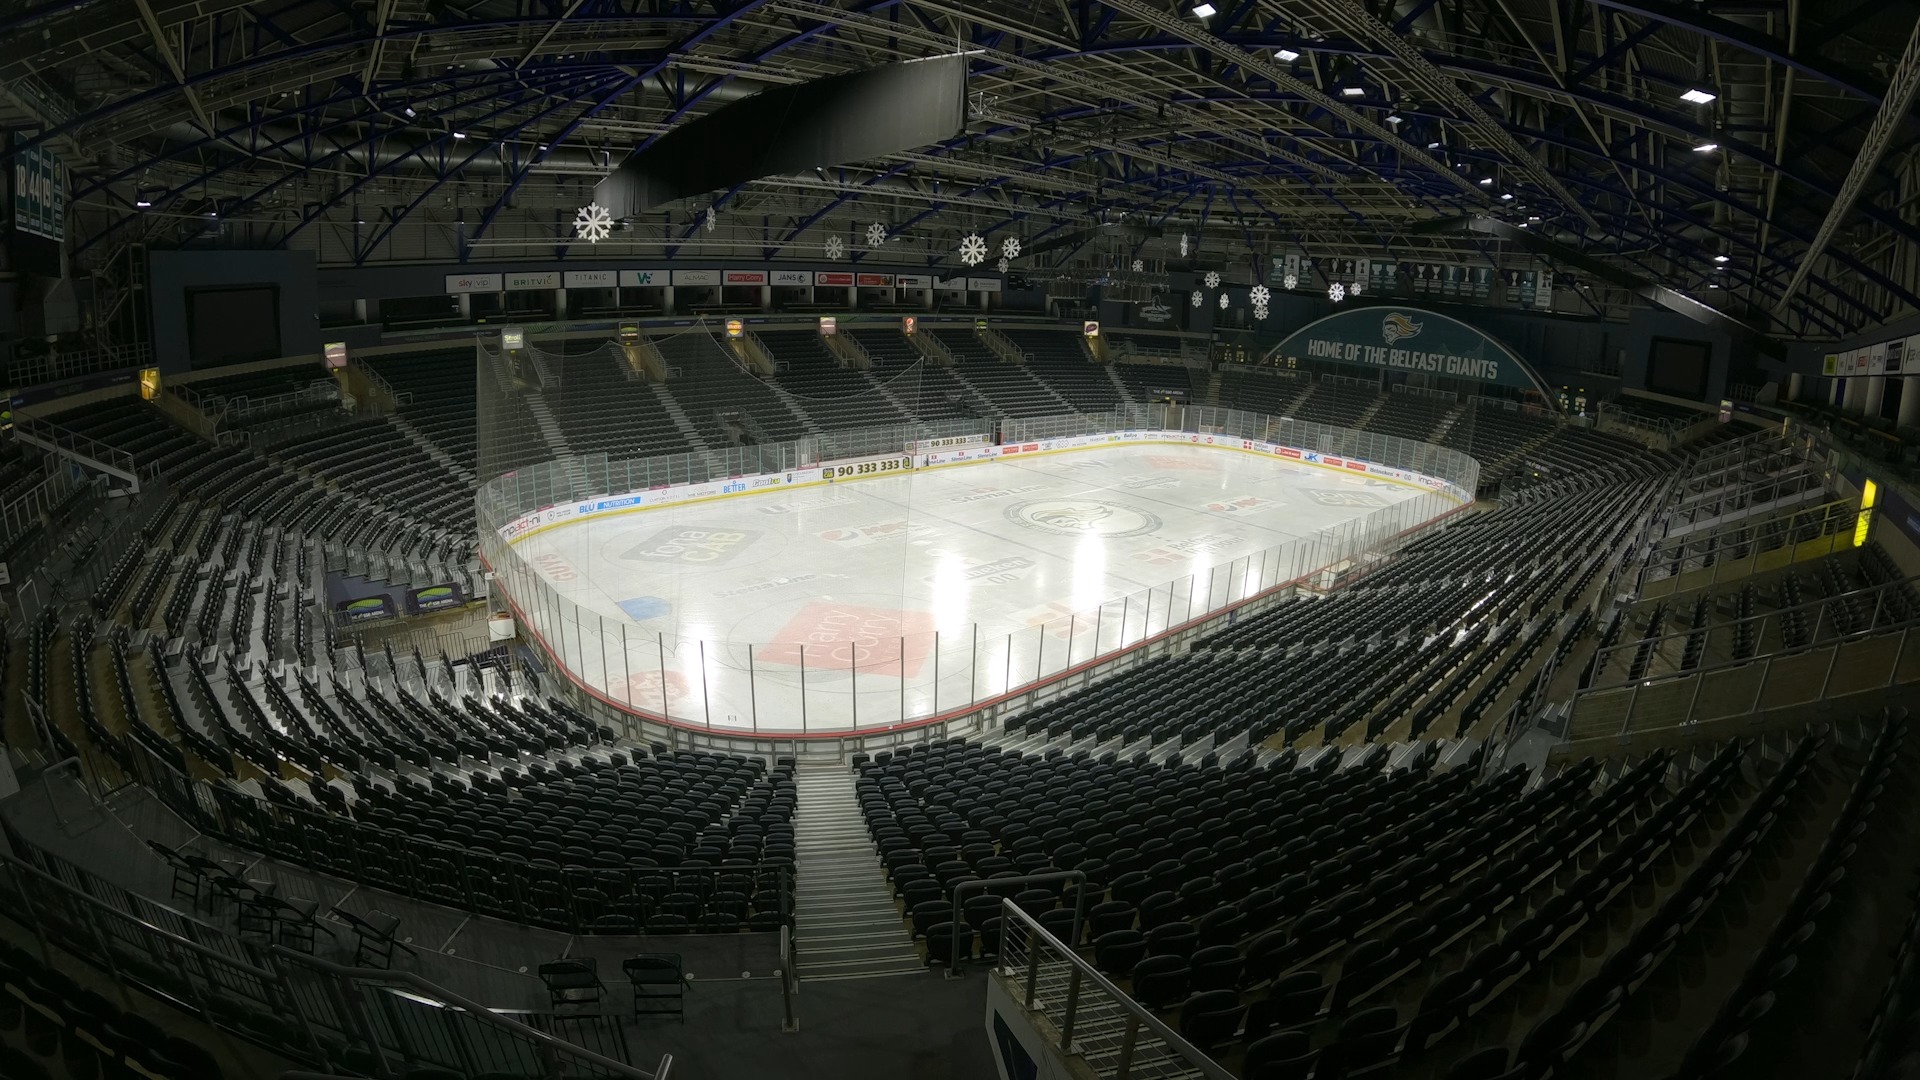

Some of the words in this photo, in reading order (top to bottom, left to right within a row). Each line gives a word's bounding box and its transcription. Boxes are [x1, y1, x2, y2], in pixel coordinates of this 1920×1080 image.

[16, 163, 26, 198] 18
[30, 170, 40, 204] 44
[42, 176, 51, 209] 19
[459, 279, 473, 289] sky
[513, 277, 553, 286] BRITVIC
[575, 273, 607, 281] TITANIC
[1308, 339, 1343, 360] HOME
[1344, 343, 1362, 362] OF
[1364, 345, 1387, 365] THE
[1389, 349, 1445, 373] BELFAST
[1446, 356, 1499, 380] GIANTS
[837, 466, 854, 477] 90
[857, 464, 877, 474] 333
[880, 460, 900, 471] 333
[723, 483, 746, 493] BETTER
[604, 498, 635, 508] NUTRITION
[784, 609, 860, 657] Harry
[830, 613, 901, 662] Corry
